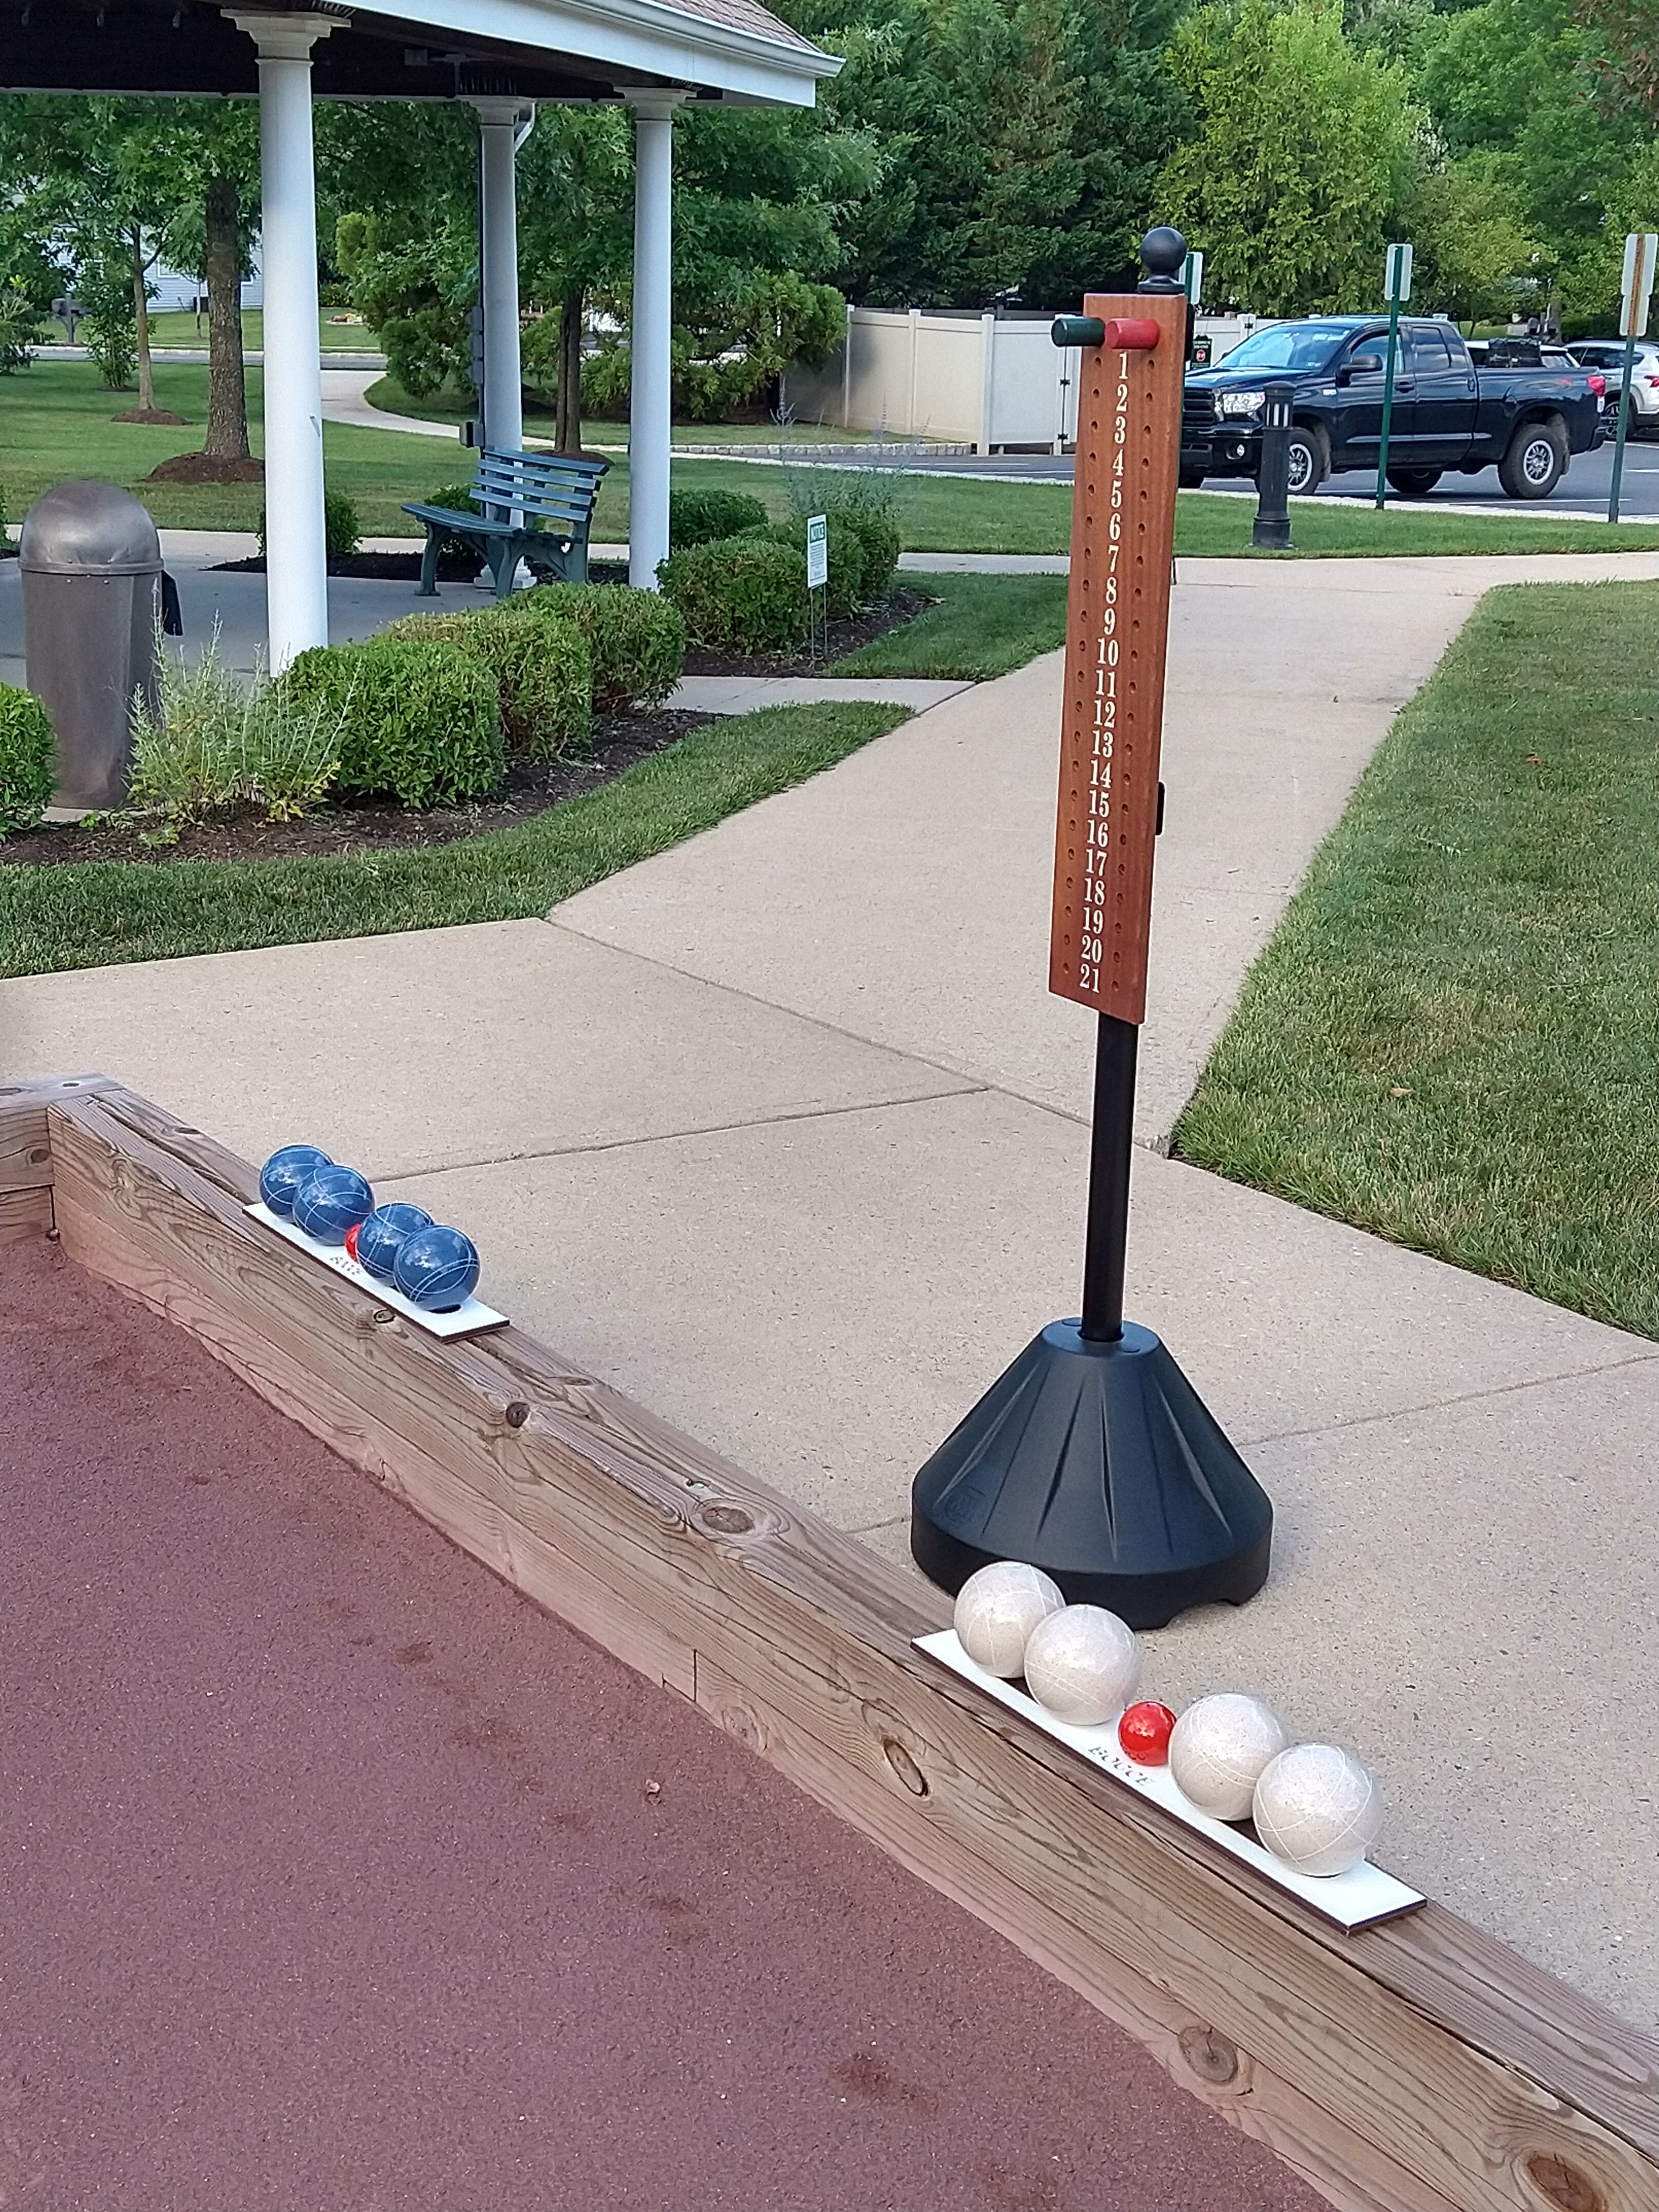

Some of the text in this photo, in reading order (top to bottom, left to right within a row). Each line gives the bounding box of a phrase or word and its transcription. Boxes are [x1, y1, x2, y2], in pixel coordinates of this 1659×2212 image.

[1118, 351, 1129, 380] 1
[1115, 383, 1129, 413] 2
[1114, 415, 1126, 445] 3
[1111, 448, 1125, 477] 4
[1110, 479, 1122, 509] 5
[1108, 512, 1121, 541] 6
[1107, 544, 1120, 573] 7
[1105, 576, 1117, 605] 8
[1103, 607, 1116, 636] 9
[1096, 637, 1119, 667] 10
[1095, 668, 1117, 699] 11
[1093, 699, 1116, 729] 12
[1092, 729, 1114, 758] 13
[1089, 758, 1112, 789] 14
[1088, 789, 1110, 818] 15
[1086, 819, 1108, 848] 16
[1085, 848, 1108, 877] 17
[1084, 877, 1106, 906] 18
[1082, 907, 1104, 935] 19
[1080, 934, 1103, 964] 20
[1079, 963, 1100, 994] 21
